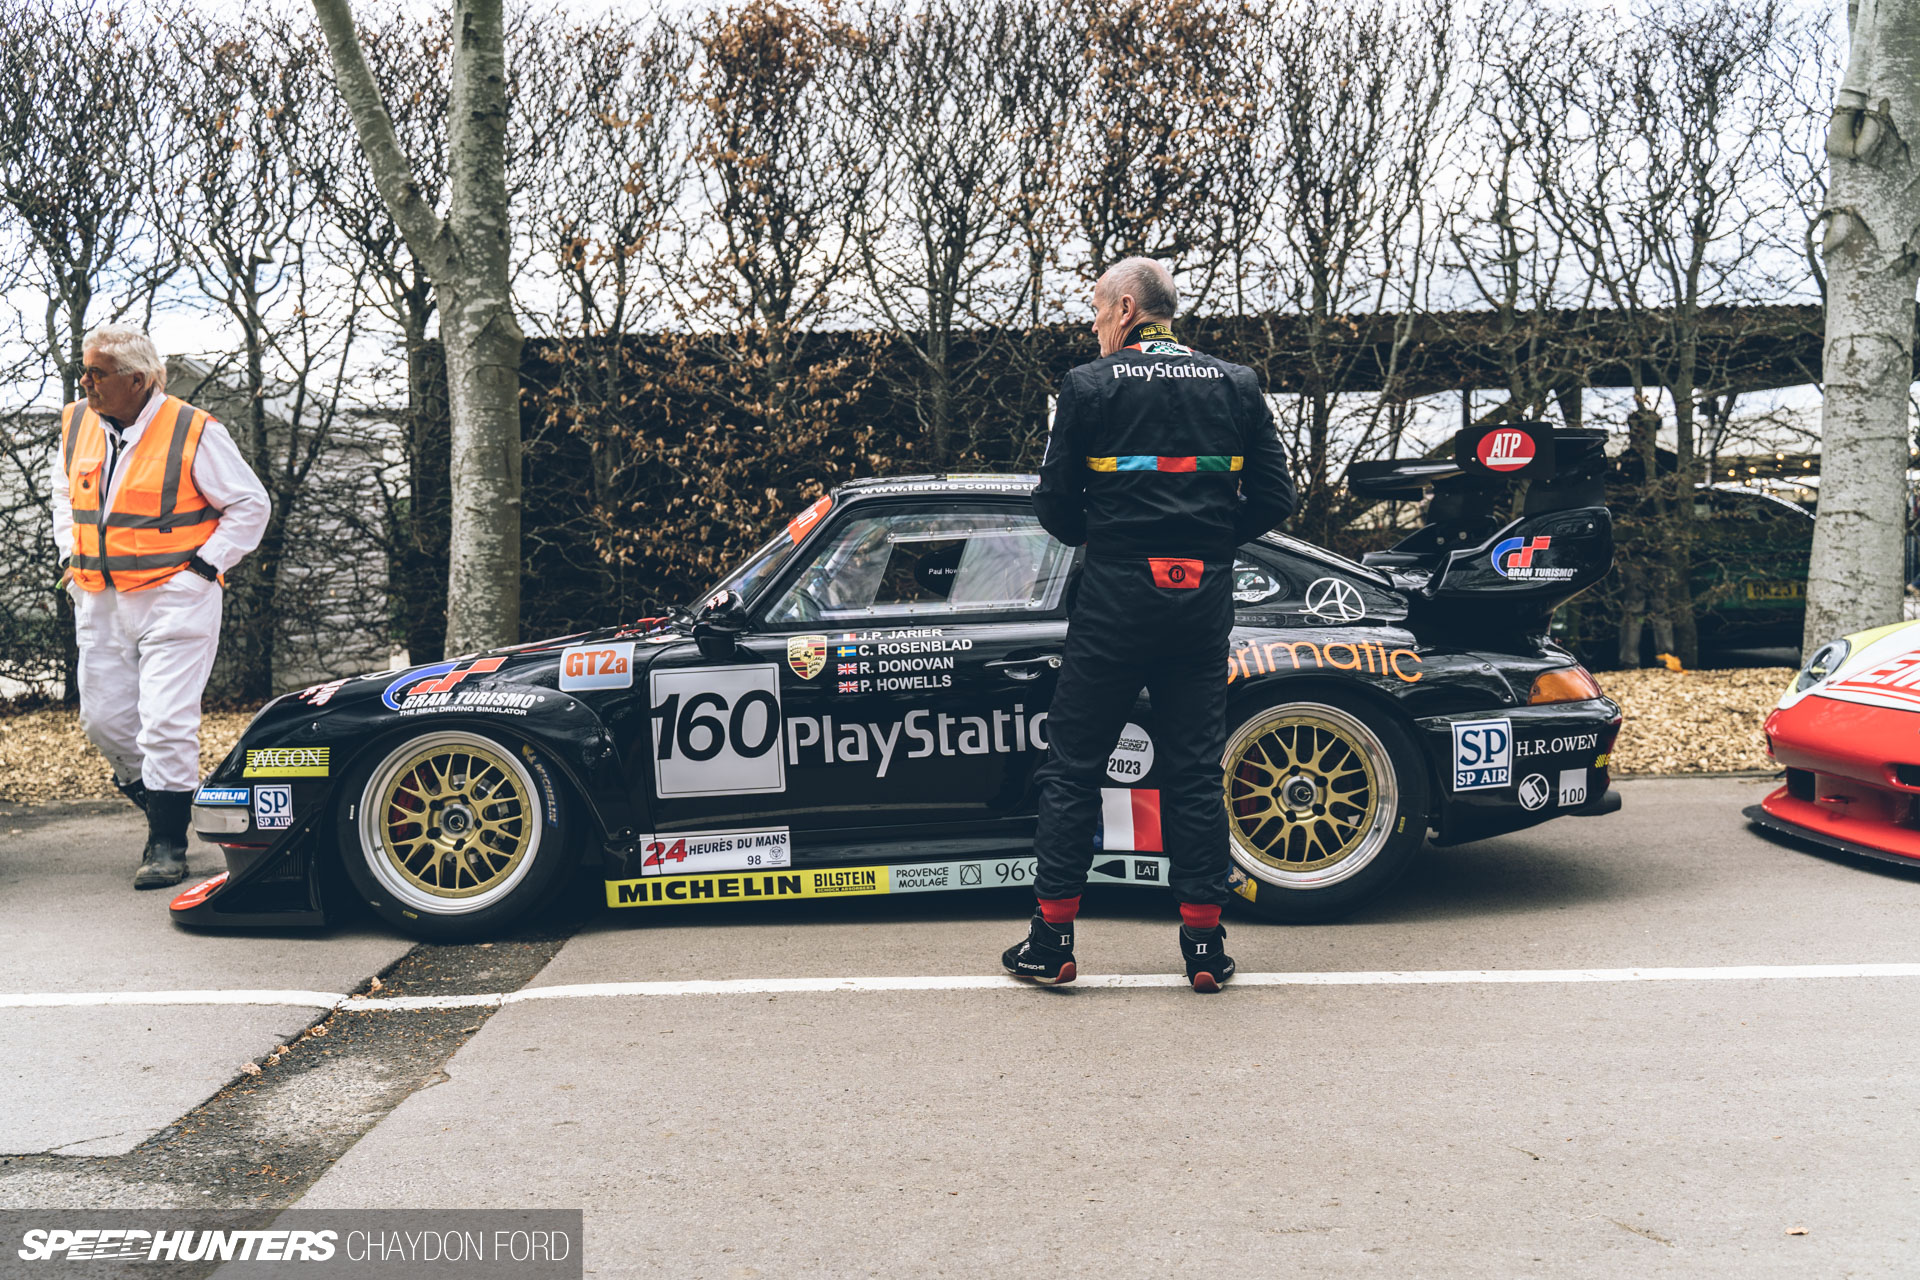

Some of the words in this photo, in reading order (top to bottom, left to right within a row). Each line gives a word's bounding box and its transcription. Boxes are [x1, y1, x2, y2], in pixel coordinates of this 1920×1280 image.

[1490, 433, 1522, 458] ATP
[1507, 568, 1533, 577] GRAN
[859, 632, 884, 641] J.P.
[888, 629, 943, 639] JARIER
[859, 644, 874, 656] C.
[878, 639, 973, 655] ROSENBLAD
[566, 650, 628, 677] GT2a
[860, 662, 875, 674] R.
[878, 657, 954, 673] DONOVAN
[860, 680, 873, 692] P.
[876, 675, 952, 691] HOWELLS
[401, 692, 453, 709] GRAN
[399, 708, 416, 717] THE
[416, 707, 437, 715] REAL
[438, 705, 474, 713] DRIVING
[476, 706, 527, 716] SIMULATOR
[651, 690, 780, 761] 160
[1459, 728, 1507, 766] SP
[1109, 758, 1141, 775] 2023
[1457, 772, 1476, 785] SP
[1480, 769, 1508, 783] AIR
[199, 791, 247, 801] MICHELIN
[259, 791, 288, 813] SP
[1561, 787, 1585, 804] 100
[259, 818, 271, 826] SP
[274, 817, 291, 826] AIR
[643, 839, 687, 867] 24
[688, 840, 733, 856] HEURES
[737, 838, 752, 849] DU
[755, 833, 787, 847] MANS
[747, 855, 761, 866] 98
[814, 871, 875, 887] BILSTEIN
[896, 867, 949, 878] PROVENCE
[1136, 865, 1158, 877] LAT
[618, 875, 802, 903] MICHELIN
[898, 877, 948, 889] MOULAGE
